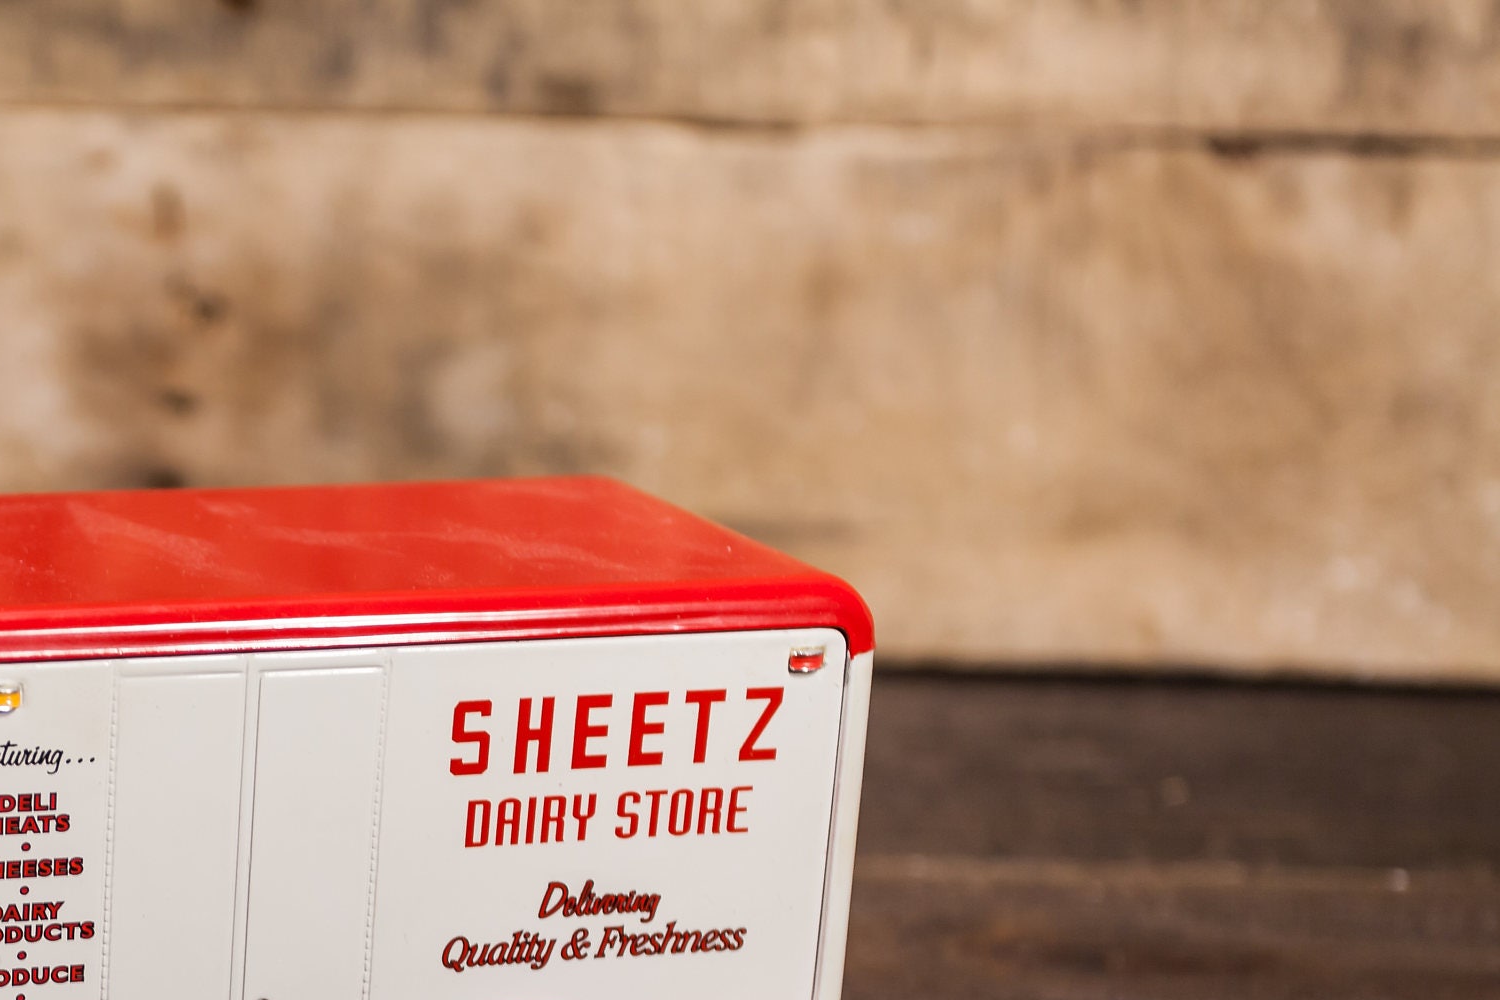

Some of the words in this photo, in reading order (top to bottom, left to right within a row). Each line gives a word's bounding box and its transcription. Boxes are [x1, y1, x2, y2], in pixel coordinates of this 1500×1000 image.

[449, 686, 785, 776] SHEETZ
[464, 793, 597, 848] DAIRY
[614, 786, 754, 839] STORE
[537, 879, 661, 923] Delivering
[441, 930, 556, 972] Quality
[560, 927, 591, 961] &
[594, 921, 748, 959] Freshness
